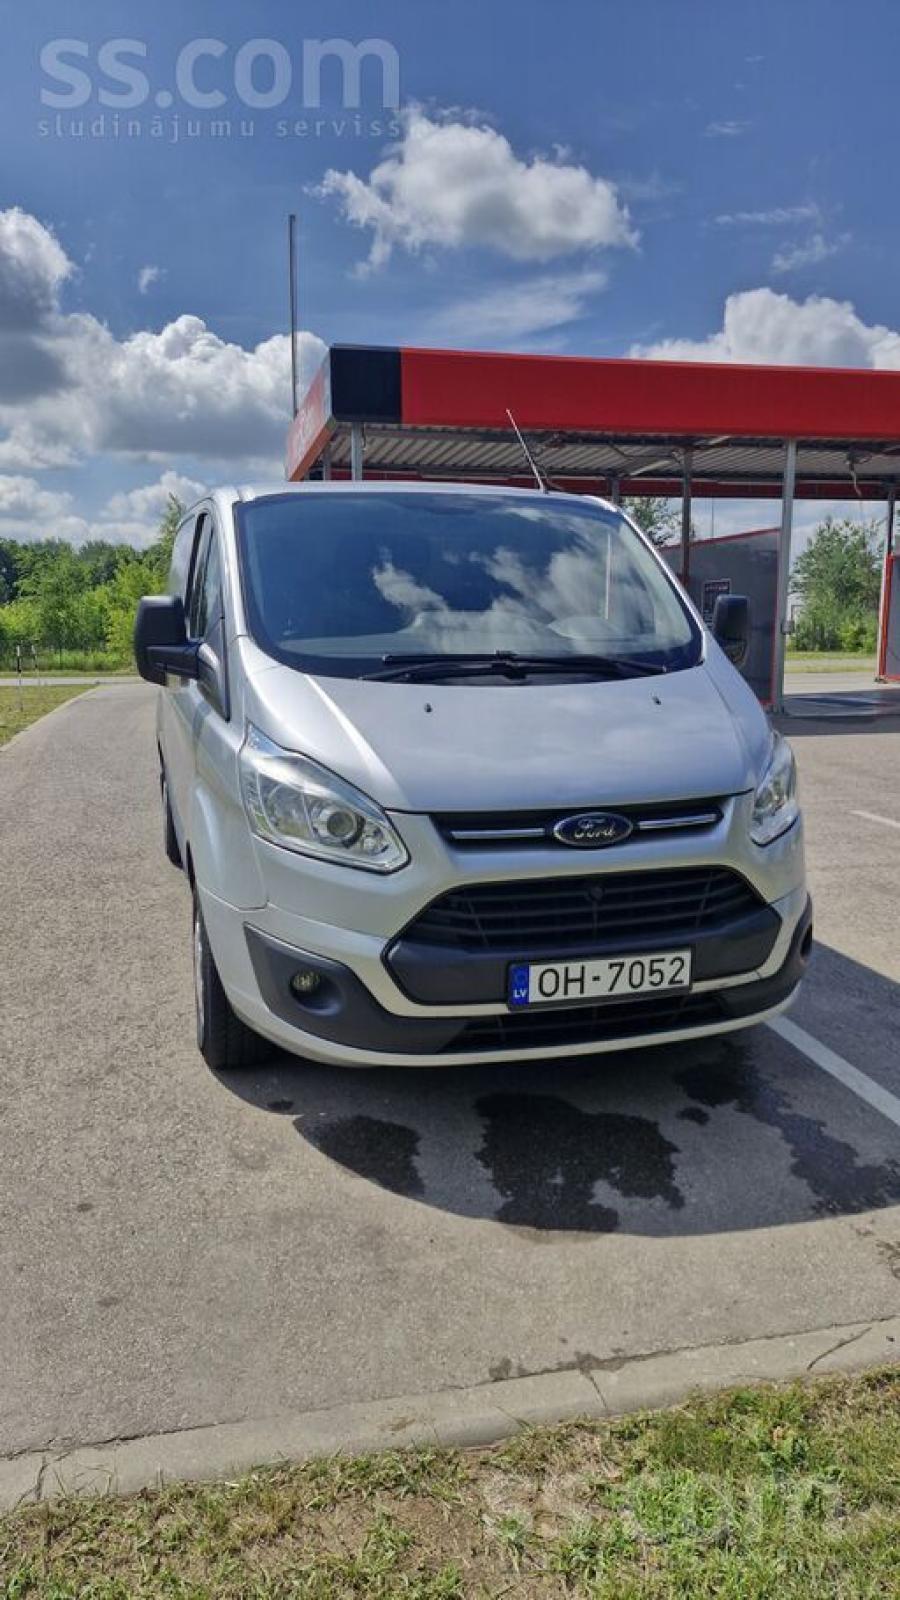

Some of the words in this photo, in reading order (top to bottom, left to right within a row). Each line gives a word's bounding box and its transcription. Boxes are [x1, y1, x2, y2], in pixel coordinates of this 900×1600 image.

[574, 817, 616, 838] Ford
[538, 956, 685, 998] OH-7052
[513, 989, 528, 999] LV
